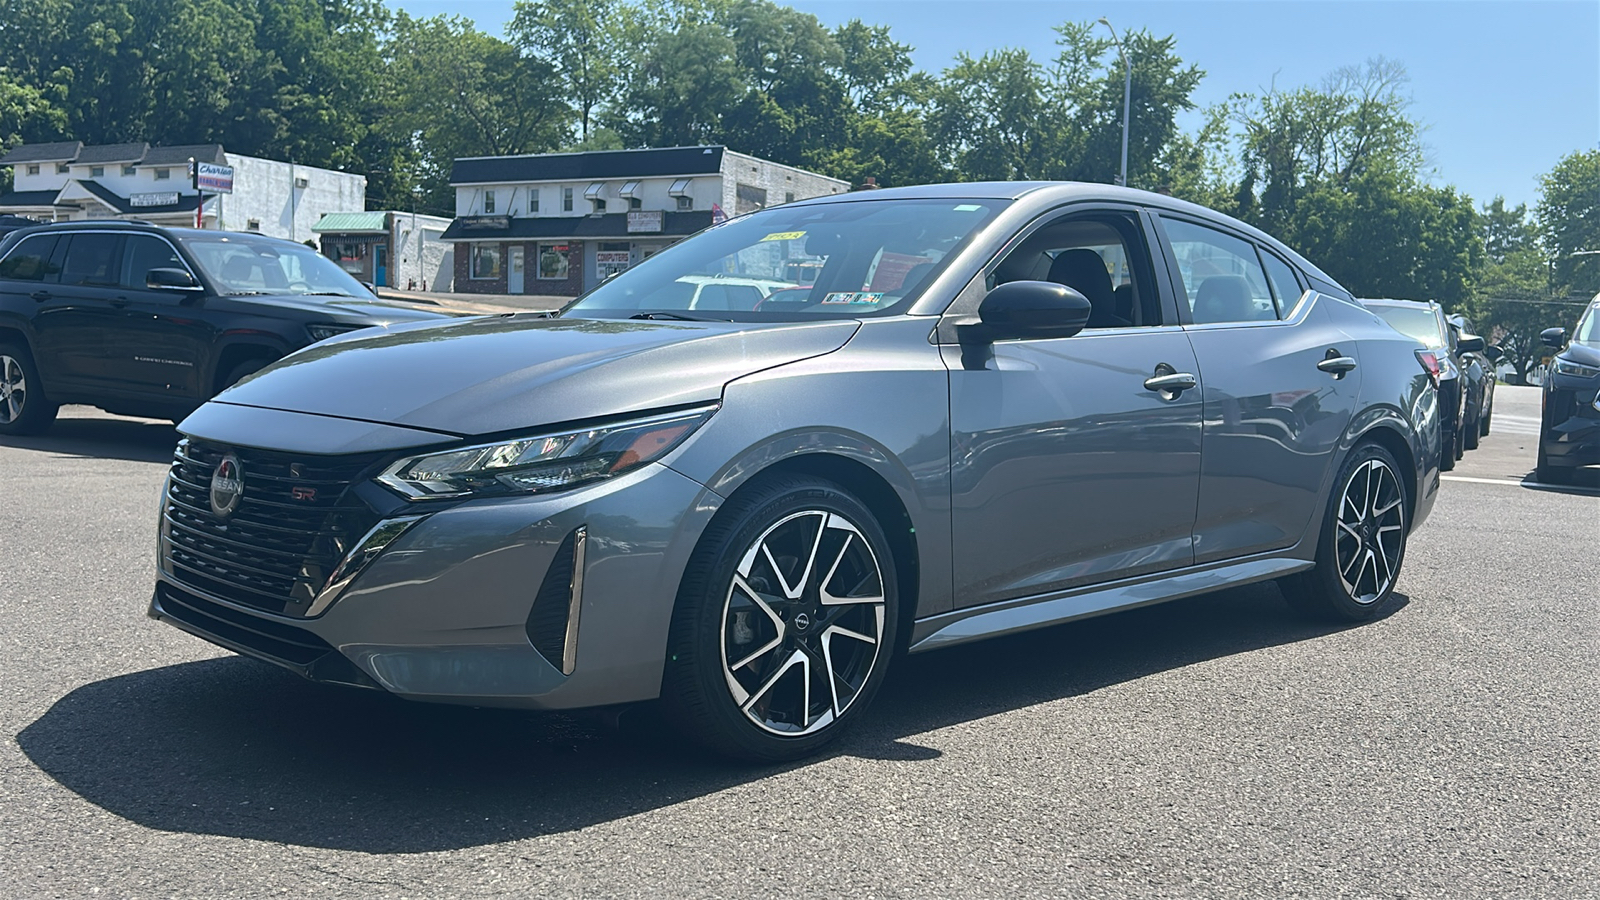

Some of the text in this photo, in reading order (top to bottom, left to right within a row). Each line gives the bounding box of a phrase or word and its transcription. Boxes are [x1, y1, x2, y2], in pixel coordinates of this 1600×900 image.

[200, 165, 232, 176] Charles
[597, 253, 629, 262] COMPUTERS
[292, 486, 316, 501] SR
